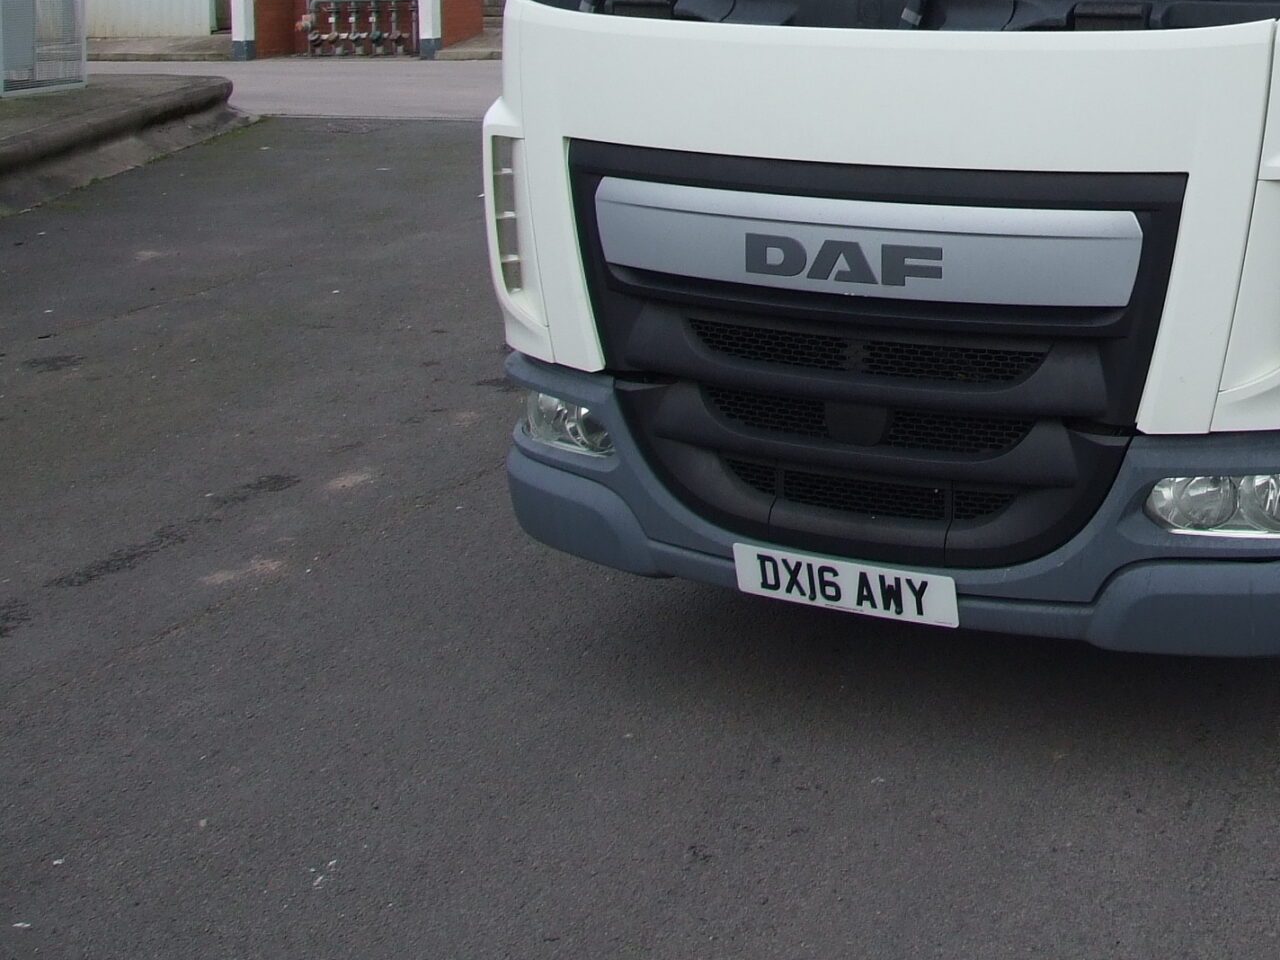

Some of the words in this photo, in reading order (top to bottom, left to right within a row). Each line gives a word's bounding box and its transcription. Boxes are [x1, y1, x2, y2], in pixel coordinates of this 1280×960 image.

[745, 232, 943, 286] DAF
[756, 553, 842, 602] DX16
[856, 571, 929, 616] AWY
